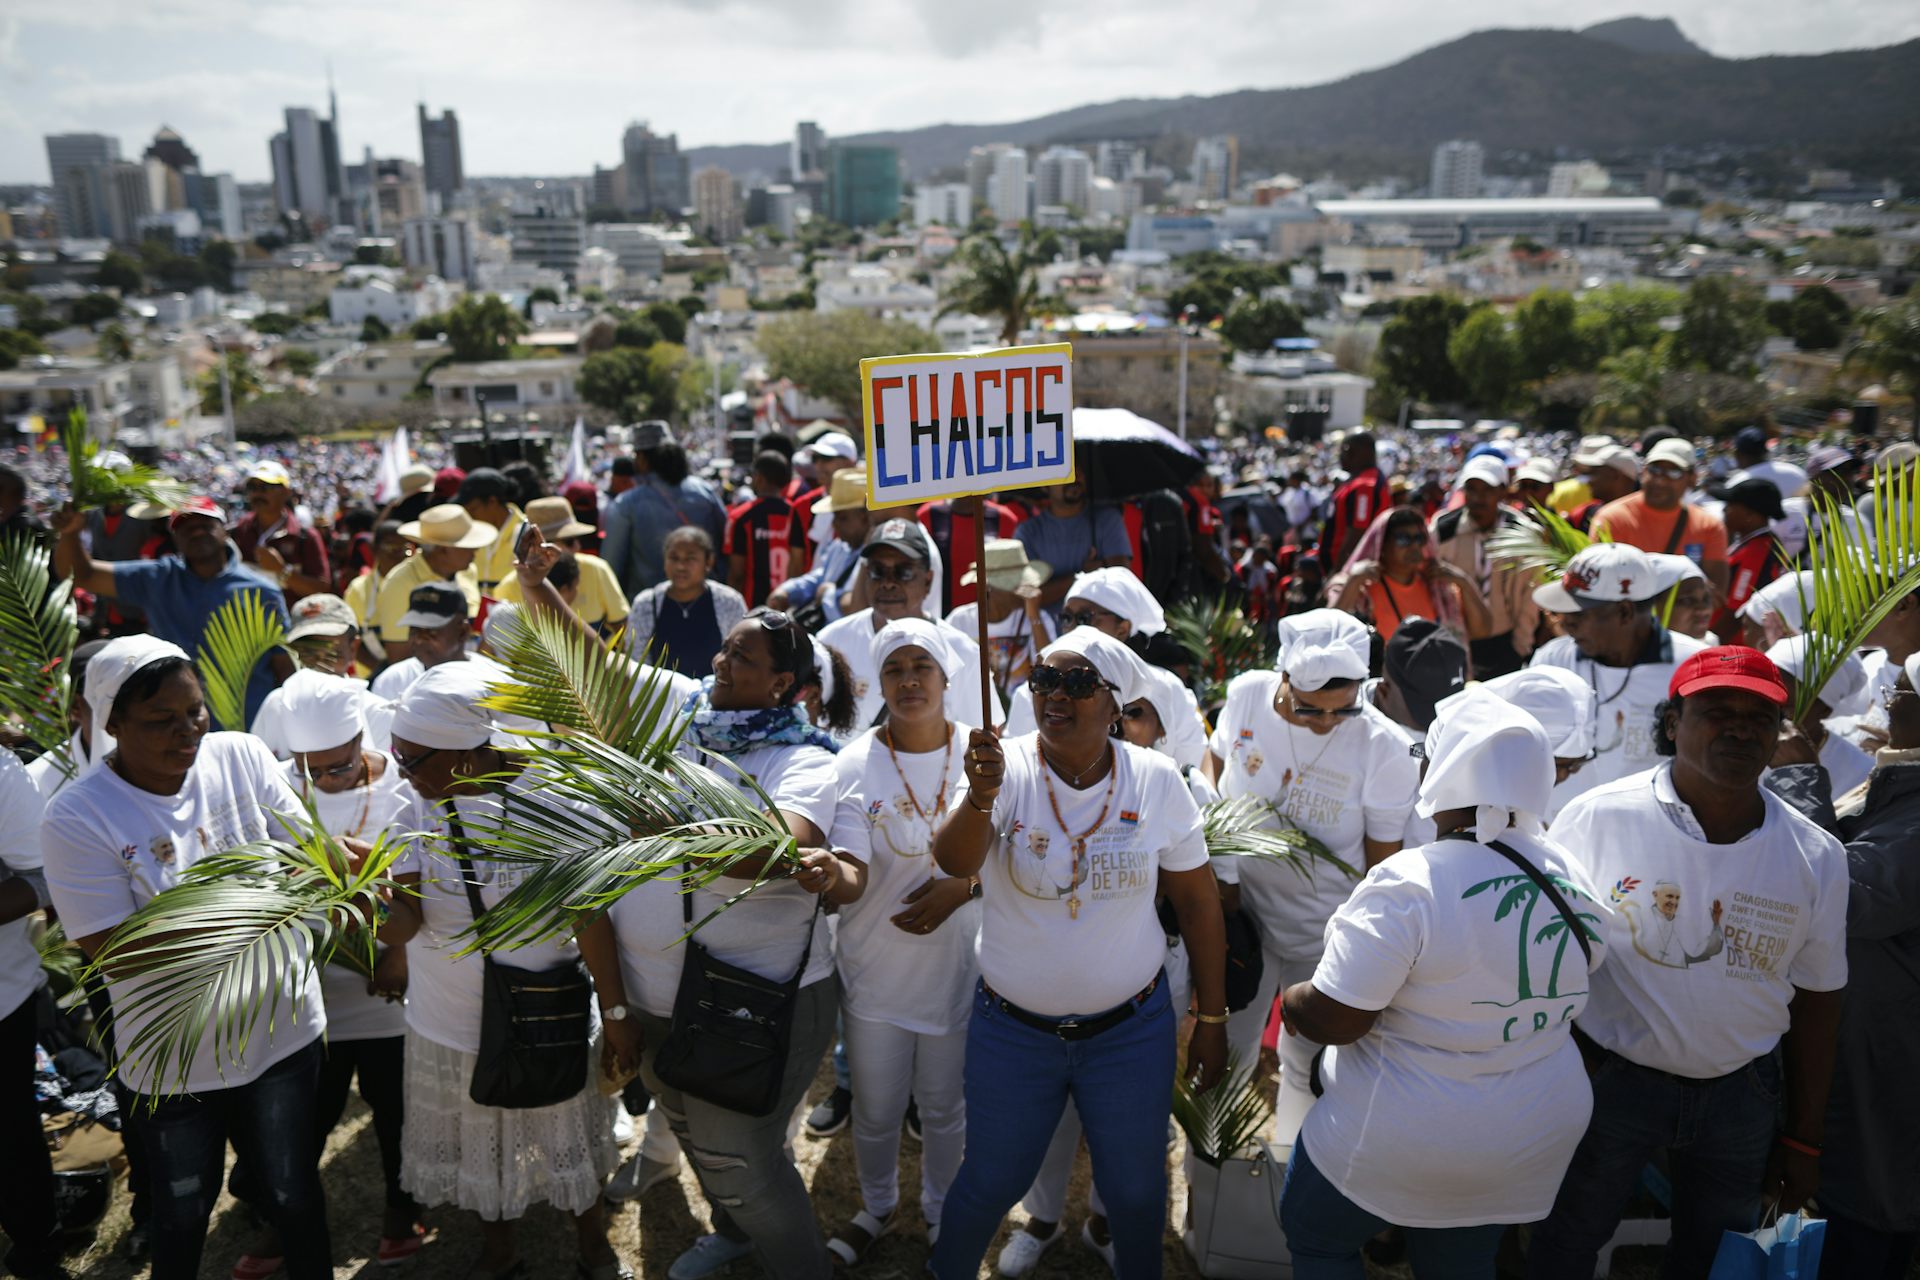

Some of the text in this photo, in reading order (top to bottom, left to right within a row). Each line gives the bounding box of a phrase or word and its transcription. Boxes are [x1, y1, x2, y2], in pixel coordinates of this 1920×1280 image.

[872, 365, 1064, 488] CHAGOS
[1092, 869, 1149, 890] DE PAIX
[1733, 891, 1800, 915] CHAGOSSIENS
[1726, 945, 1746, 969] DE
